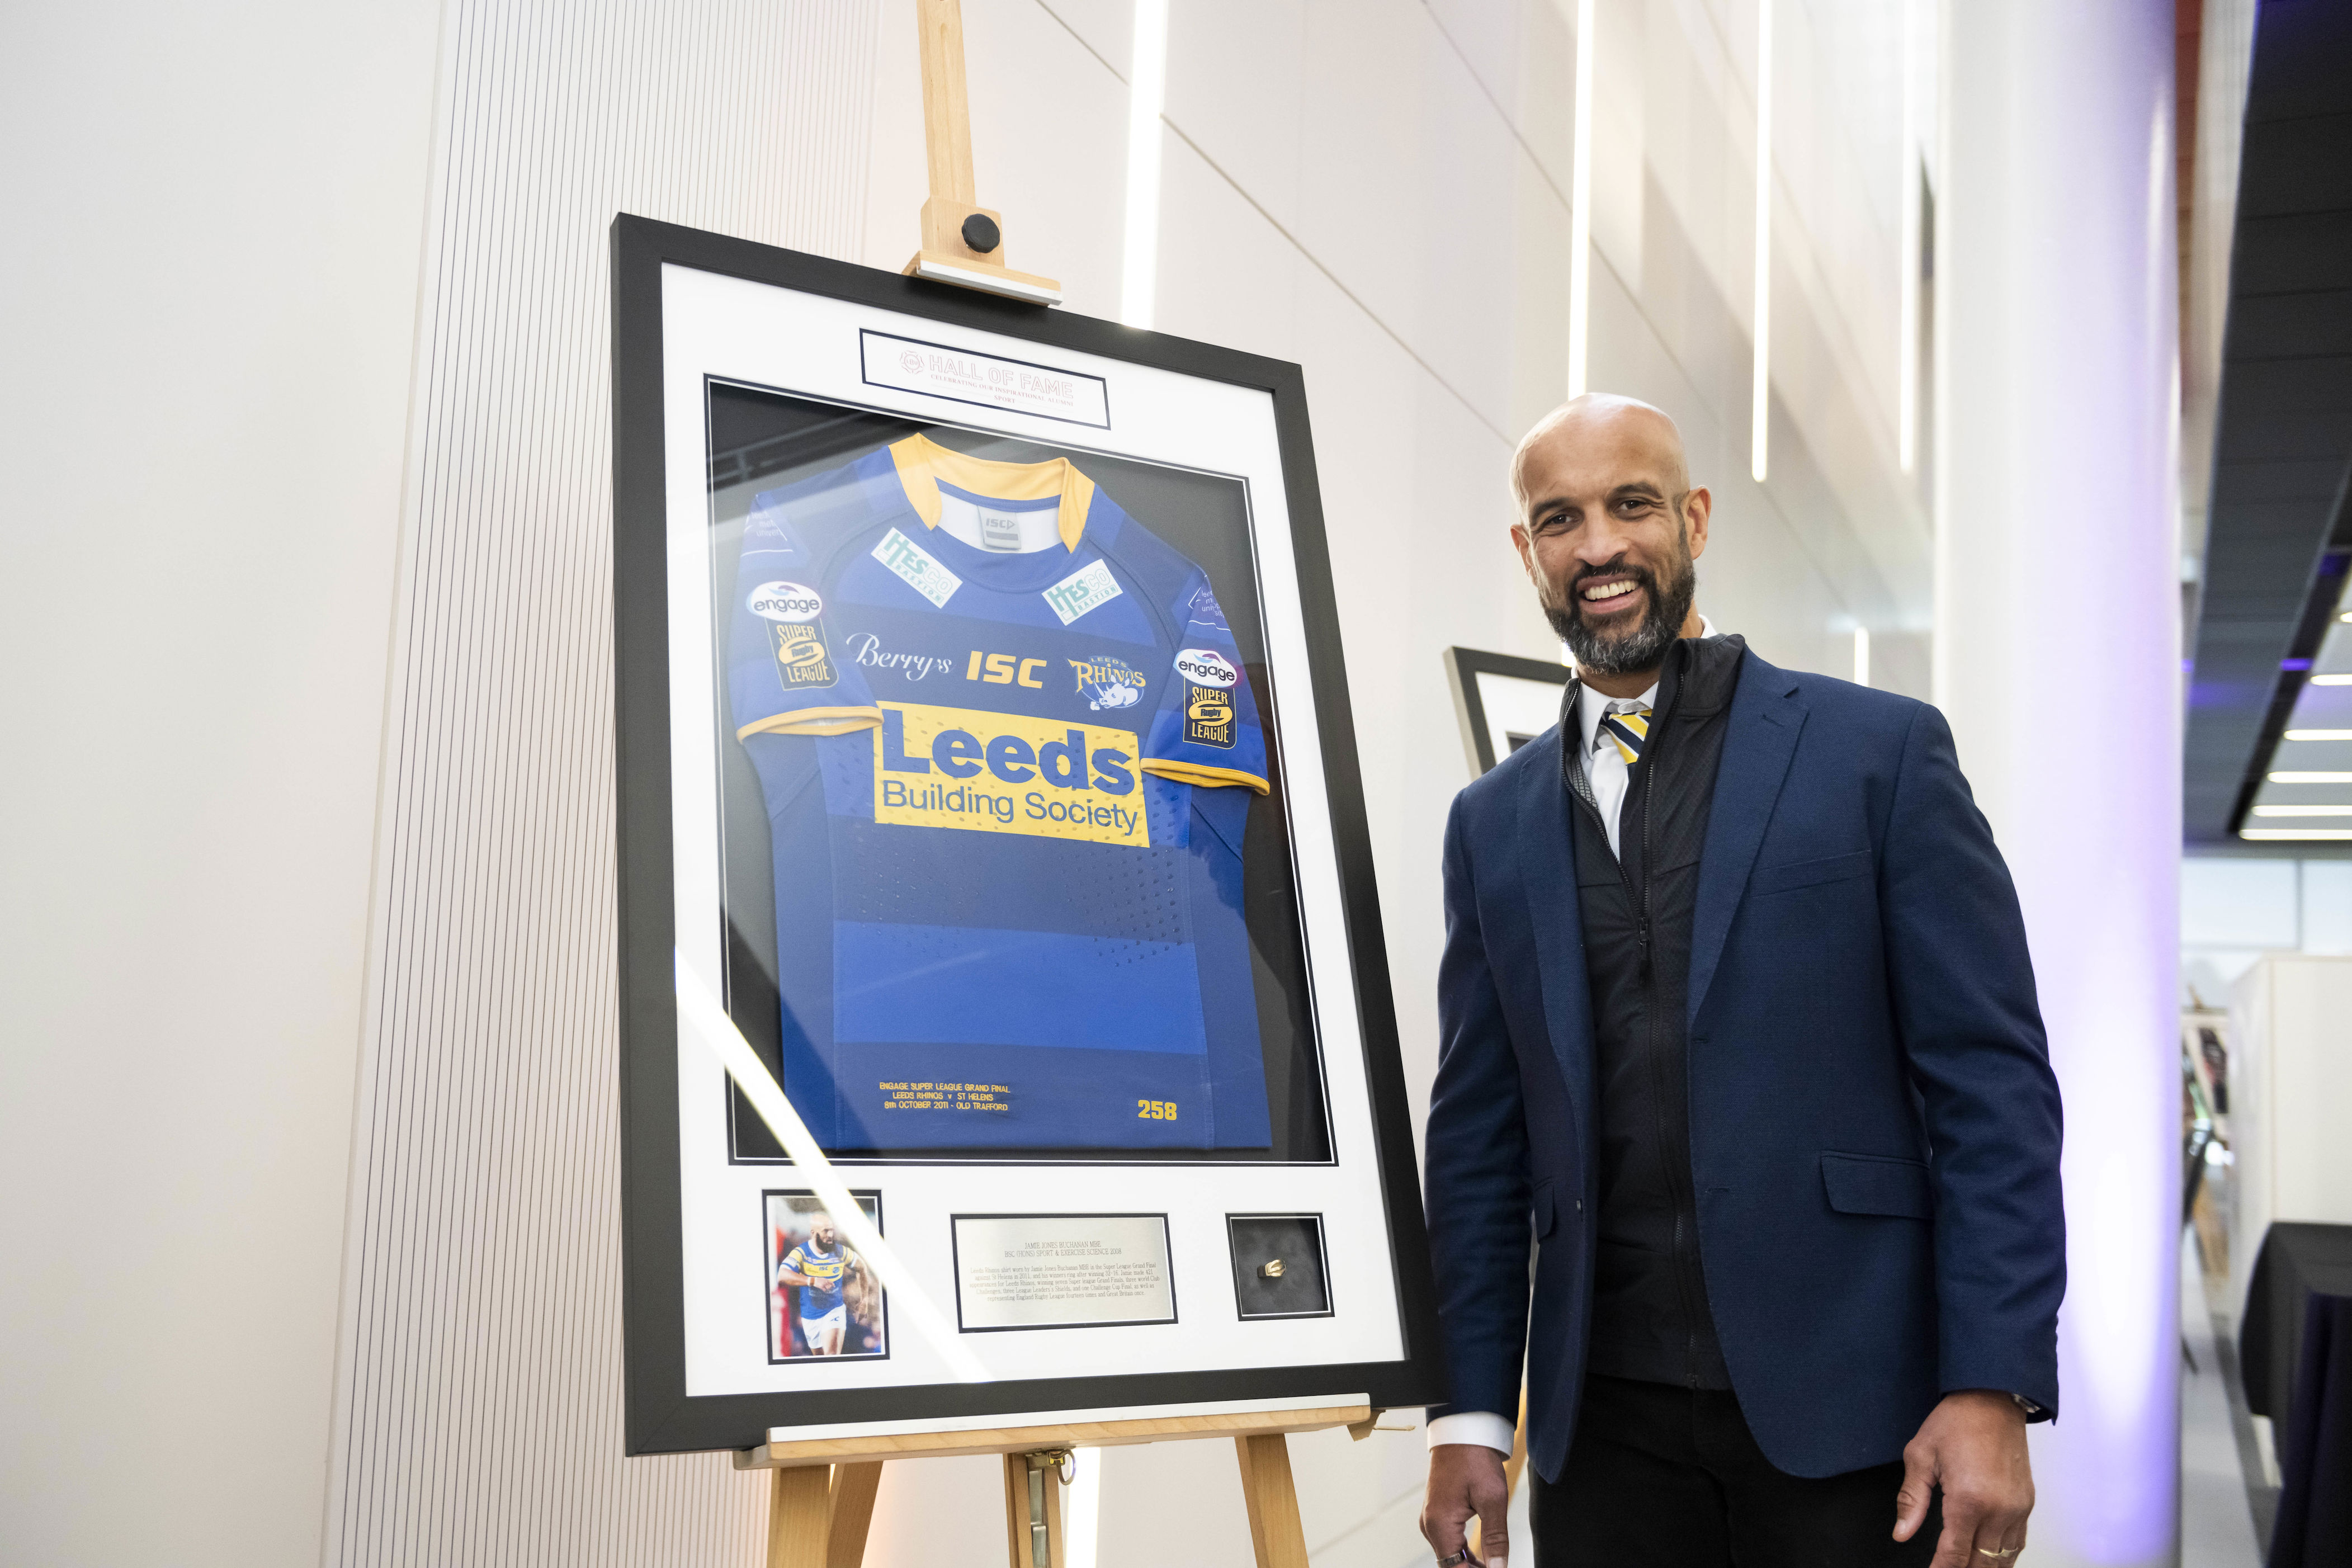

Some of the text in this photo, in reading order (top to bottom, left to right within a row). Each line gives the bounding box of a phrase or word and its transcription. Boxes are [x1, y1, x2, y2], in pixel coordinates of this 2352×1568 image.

[929, 355, 1074, 399] HALL OF FAME
[931, 374, 977, 388] CELEBRATING
[995, 386, 1046, 401] INSPIRATIONAL
[1048, 397, 1074, 407] ALUMNI
[994, 395, 1016, 404] SPORT
[986, 518, 1007, 528] ISC
[753, 599, 820, 613] engage
[1077, 586, 1116, 611] BASTION
[776, 624, 817, 645] SUPER
[791, 645, 814, 658] Rugby
[846, 632, 952, 681] Berry's
[786, 660, 830, 683] LEAGUE
[966, 650, 1047, 689] ISC
[1090, 657, 1127, 668] LEEDS
[1178, 660, 1235, 682] engage
[1192, 686, 1229, 705] SUPER
[1200, 708, 1222, 717] Rugby
[1192, 722, 1229, 743] LEAGUE
[882, 709, 1135, 796] Leeds
[883, 780, 1138, 837] Building Society
[879, 1082, 909, 1090] ENGAGE
[936, 1083, 962, 1091] LEAGUE
[965, 1084, 989, 1092] GRAND
[991, 1085, 1010, 1093] FINAL
[968, 1093, 994, 1101] HELENS
[884, 1101, 896, 1109] 8th
[956, 1102, 971, 1110] OLD
[973, 1102, 1008, 1111] TRAFFORD
[1138, 1099, 1177, 1121] 258
